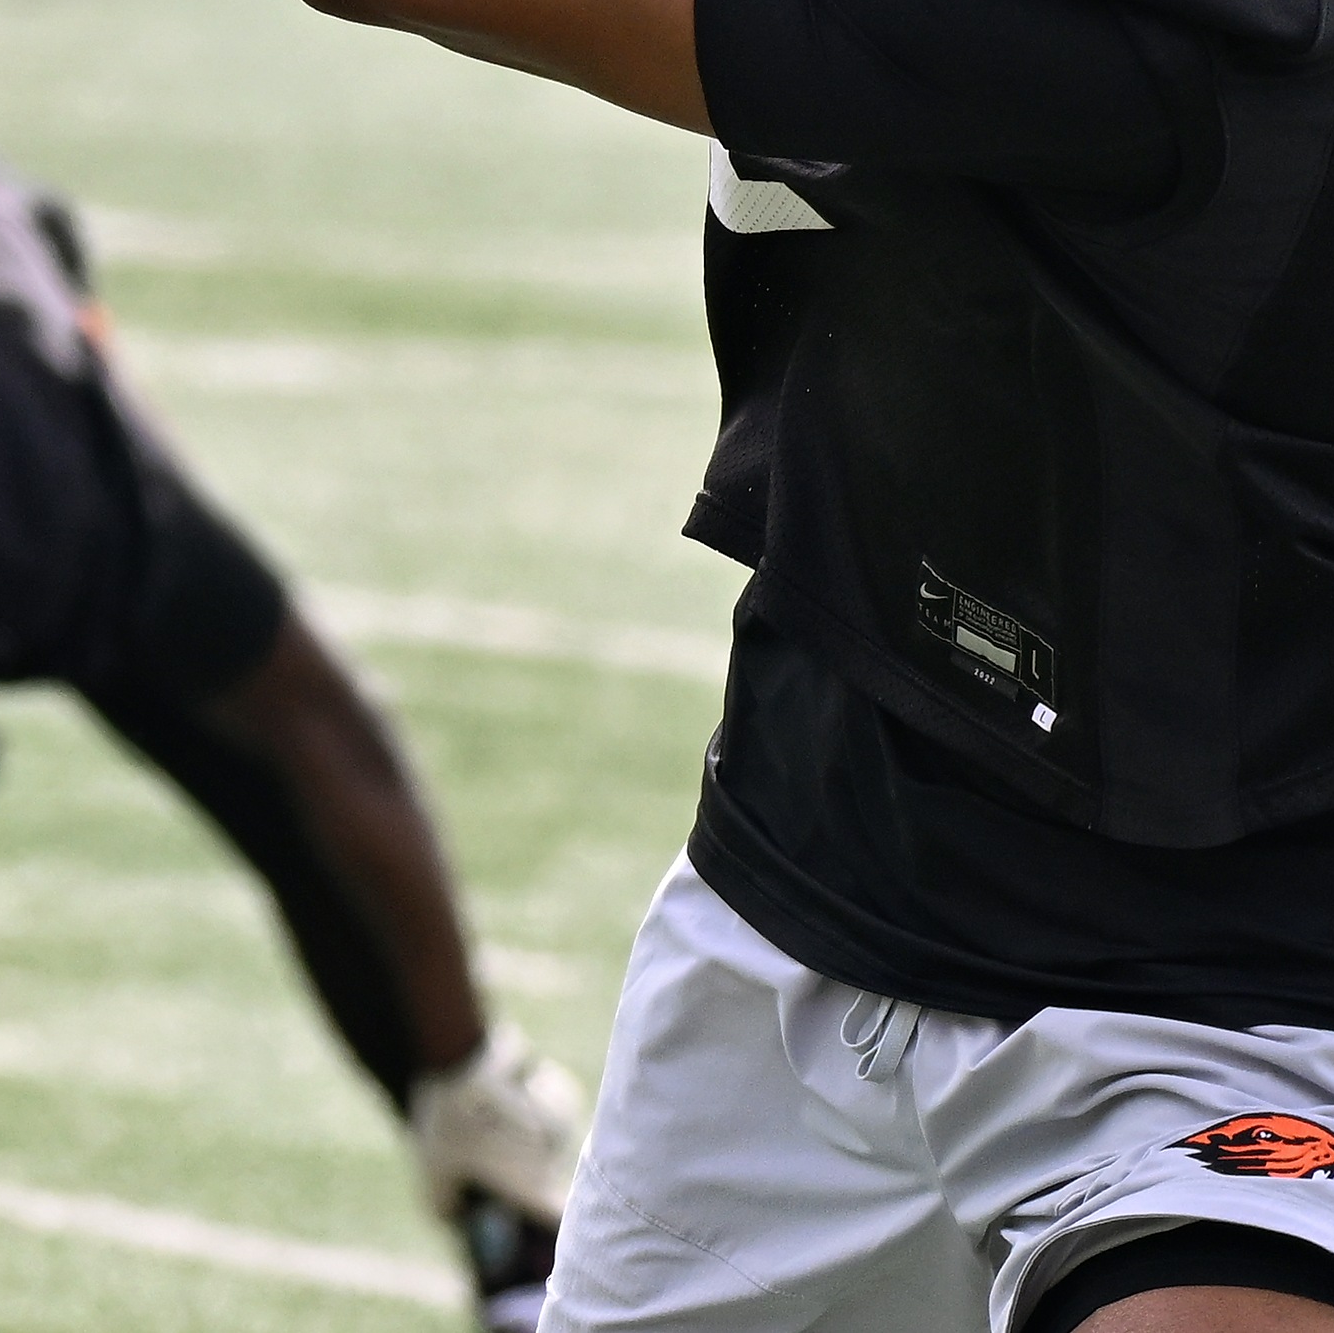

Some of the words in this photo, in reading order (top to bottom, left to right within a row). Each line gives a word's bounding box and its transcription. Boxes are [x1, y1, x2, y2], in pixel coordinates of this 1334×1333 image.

[918, 602, 952, 628] TEAM
[959, 595, 1017, 634] ENGINEERED
[973, 667, 995, 686] 2022
[1039, 710, 1047, 725] L
